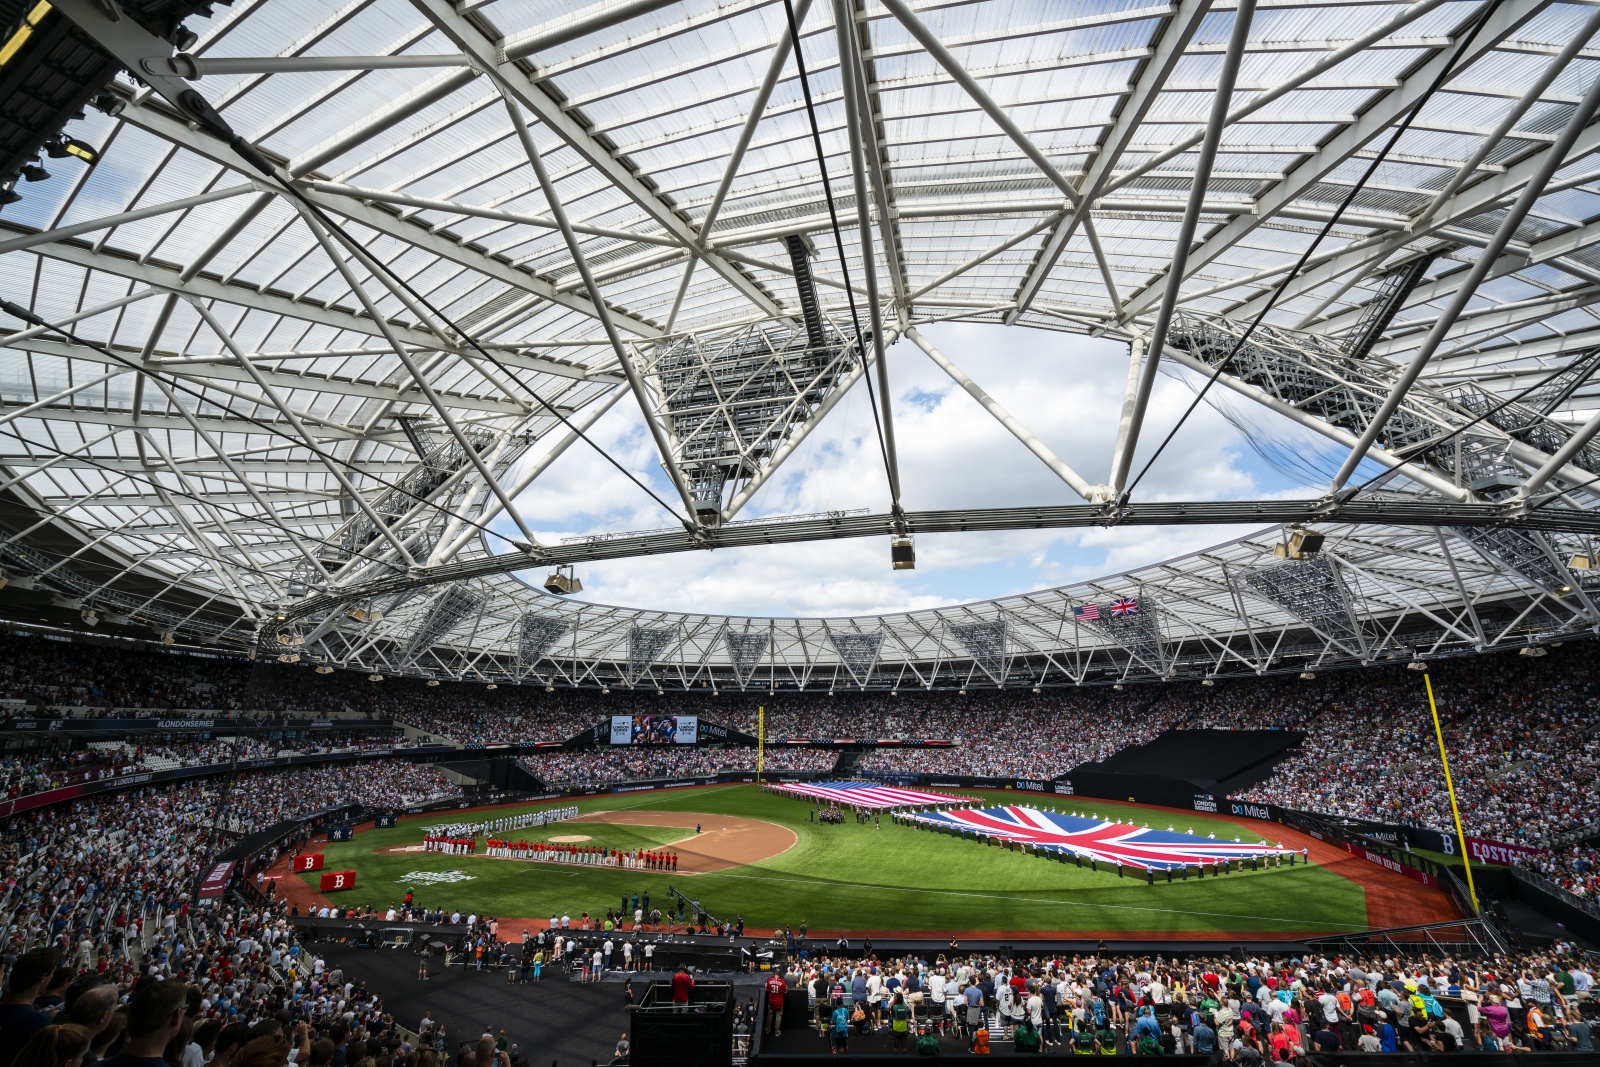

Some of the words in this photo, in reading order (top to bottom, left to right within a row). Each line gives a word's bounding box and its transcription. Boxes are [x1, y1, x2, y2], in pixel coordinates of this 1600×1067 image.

[157, 720, 215, 728] #LONDONSERIES
[709, 725, 728, 737] Mitel
[117, 777, 134, 786] LONDON
[1026, 780, 1044, 791] Mitel
[1193, 800, 1217, 808] LONDON
[1194, 804, 1214, 813] SERIES
[1244, 804, 1271, 820] Mitel
[1375, 831, 1398, 841] Mitel
[1440, 833, 1455, 855] B
[304, 857, 314, 869] B
[1365, 851, 1383, 866] BOSTON
[1382, 857, 1392, 870] RED
[1392, 861, 1402, 873] SOX
[334, 874, 344, 888] B
[770, 984, 779, 994] 31
[1004, 993, 1009, 1002] 2
